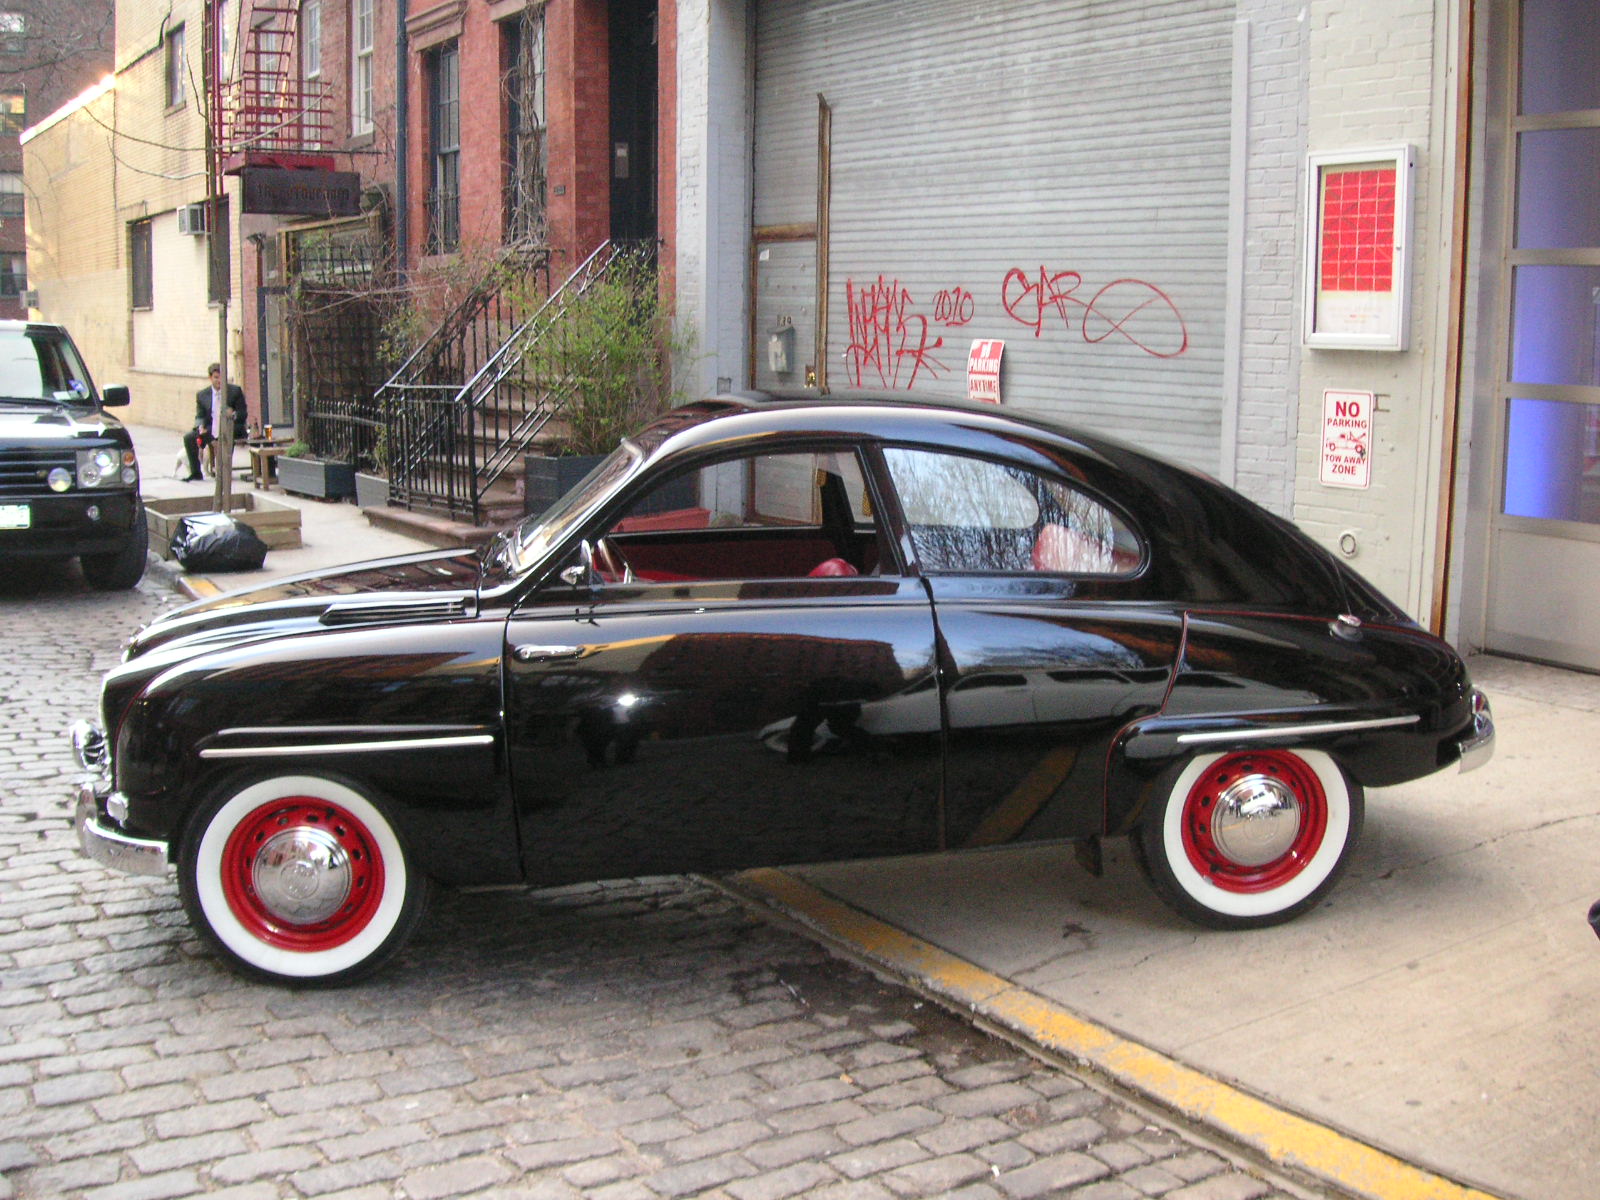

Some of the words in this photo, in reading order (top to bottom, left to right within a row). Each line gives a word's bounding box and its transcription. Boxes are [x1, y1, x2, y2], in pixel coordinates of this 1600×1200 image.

[969, 357, 999, 374] PARKING
[969, 378, 997, 393] ANYTIME
[1335, 400, 1360, 417] NO
[1327, 417, 1367, 429] PARKING
[1325, 454, 1341, 463] TOW
[1343, 455, 1366, 465] AWAY
[1331, 463, 1357, 475] ZONE
